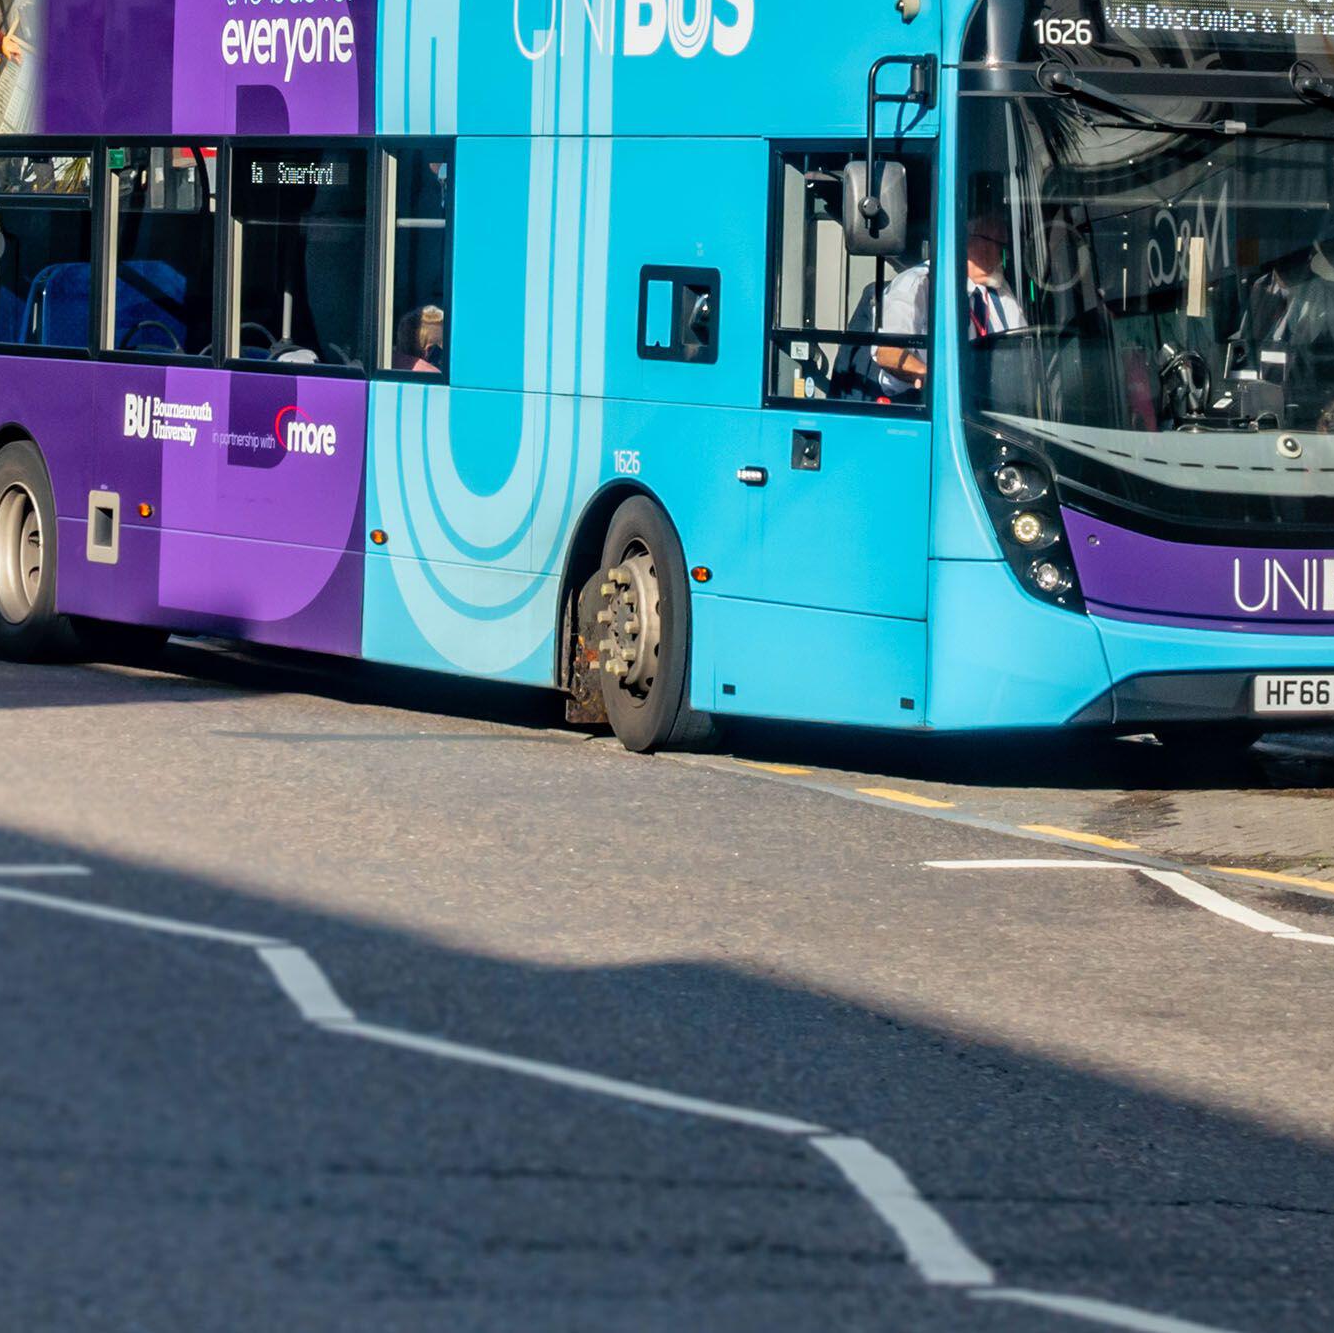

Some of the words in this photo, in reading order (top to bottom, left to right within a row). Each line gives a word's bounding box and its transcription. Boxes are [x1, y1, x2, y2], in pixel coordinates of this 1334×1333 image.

[1033, 18, 1093, 45] 1626
[1104, 2, 1141, 29] via
[1146, 3, 1257, 33] Boscombe
[1261, 7, 1278, 34] &
[221, 16, 355, 83] everyone
[277, 161, 334, 185] Somerford
[123, 393, 152, 439] BU
[152, 397, 213, 422] Bournemouth
[152, 419, 198, 447] University
[219, 430, 260, 453] partnership
[260, 433, 276, 449] with
[287, 420, 337, 456] more
[613, 450, 641, 475] 1626
[1266, 679, 1331, 705] HF66
